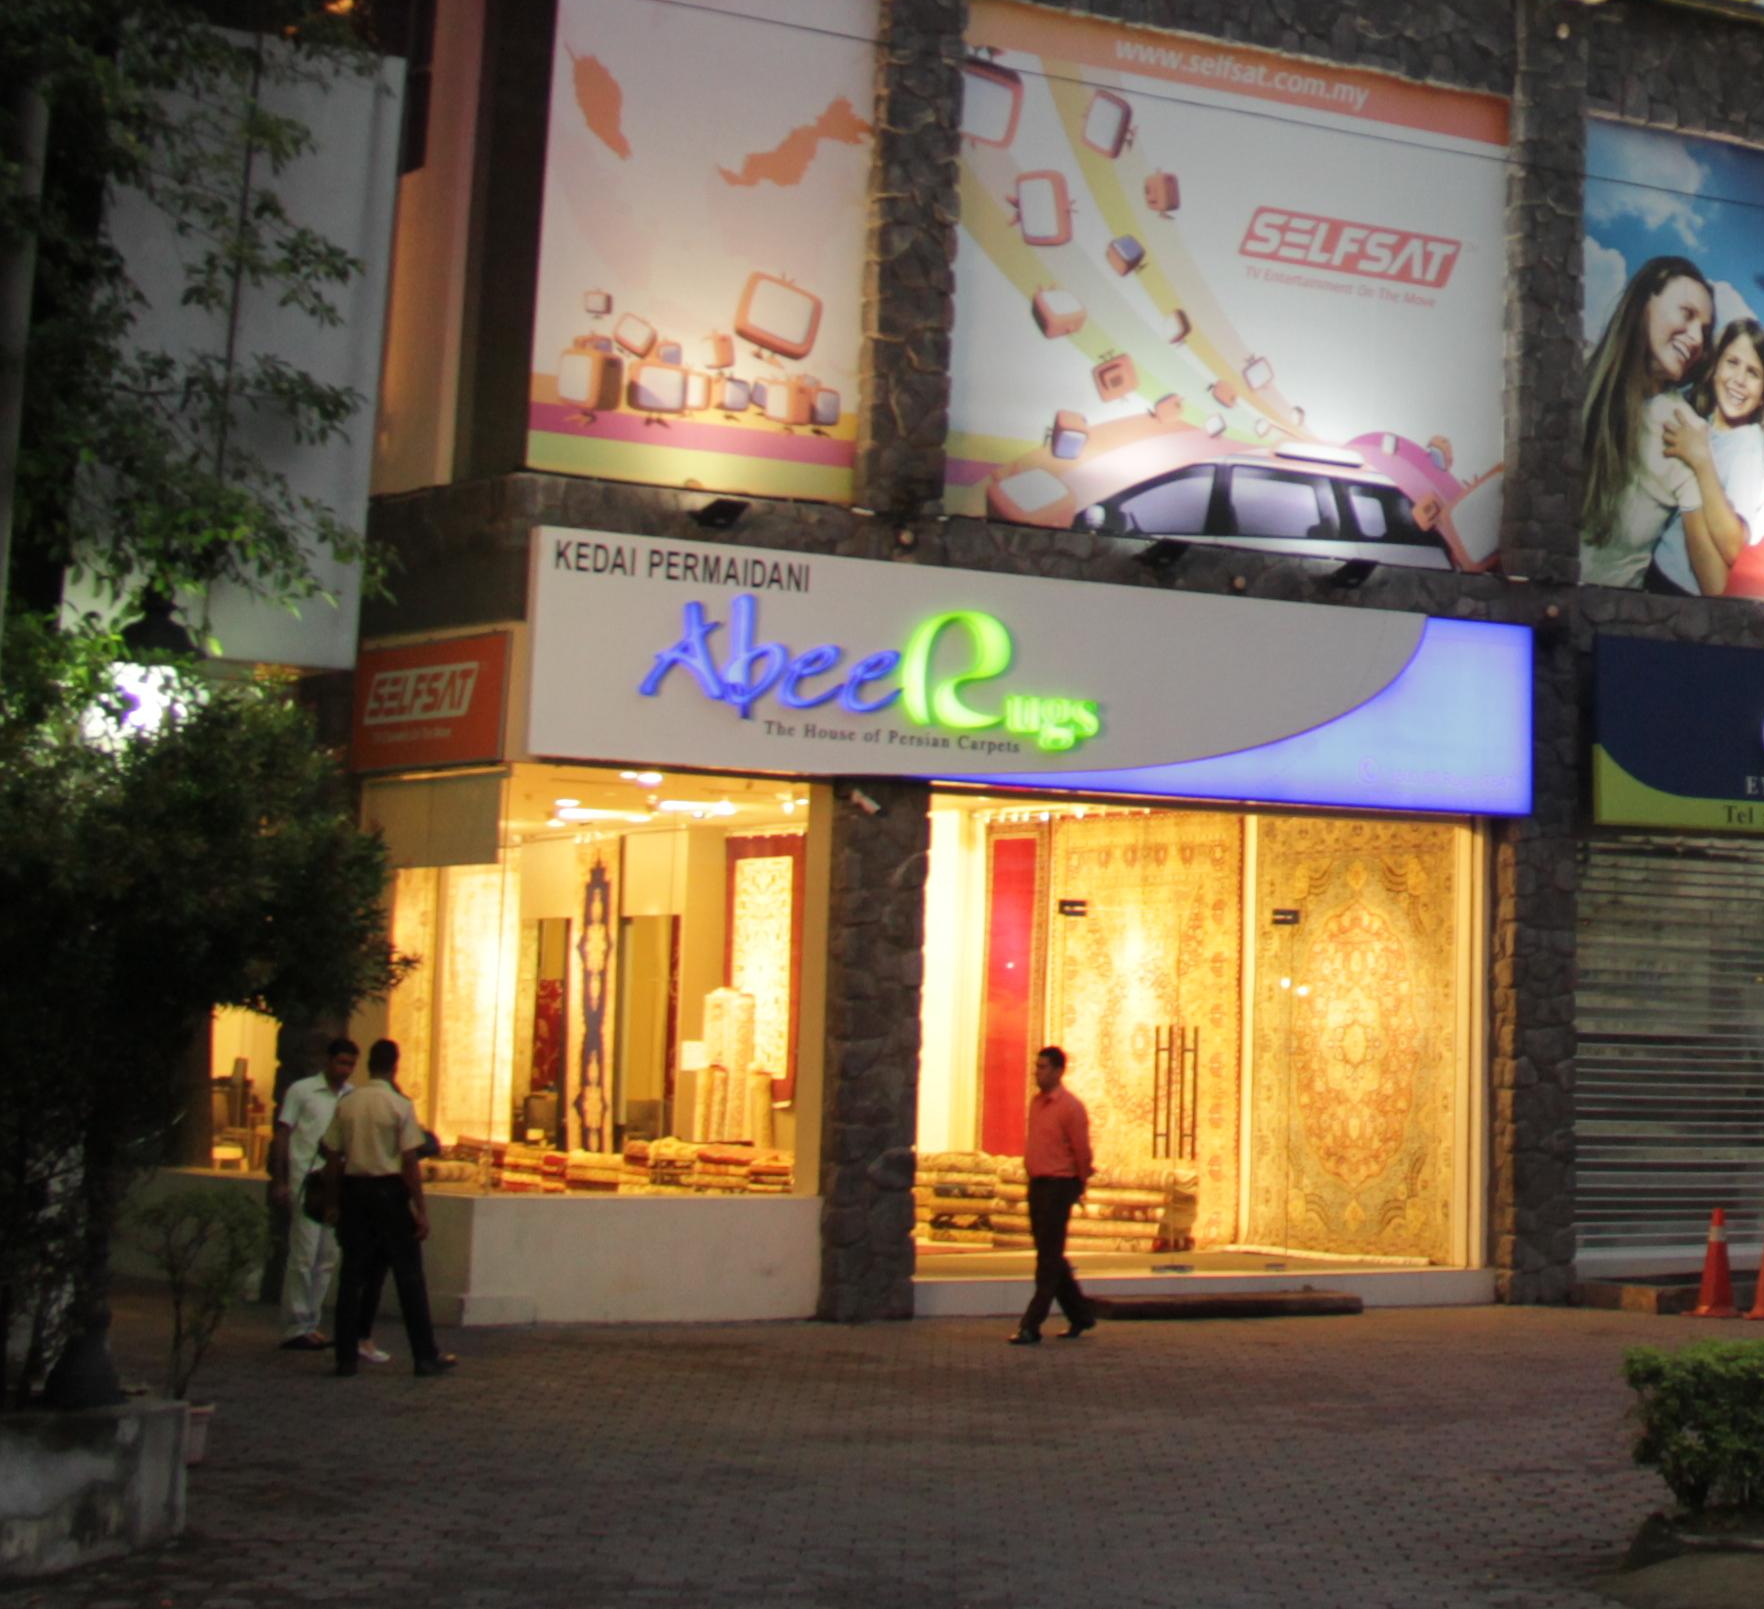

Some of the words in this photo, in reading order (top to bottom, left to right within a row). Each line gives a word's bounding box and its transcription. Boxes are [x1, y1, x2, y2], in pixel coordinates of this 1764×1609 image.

[1115, 38, 1371, 111] www.selfsat.com.my
[1245, 212, 1458, 284] SELFSAT
[554, 539, 636, 577] KEDAI
[648, 544, 811, 592] PERMAIDANI
[366, 668, 474, 718] SELFSAT
[764, 720, 796, 737] The
[803, 724, 856, 742] House
[863, 727, 882, 743] of
[888, 731, 950, 749] Persian
[957, 736, 1021, 755] Carpets
[1723, 805, 1754, 826] Tel
